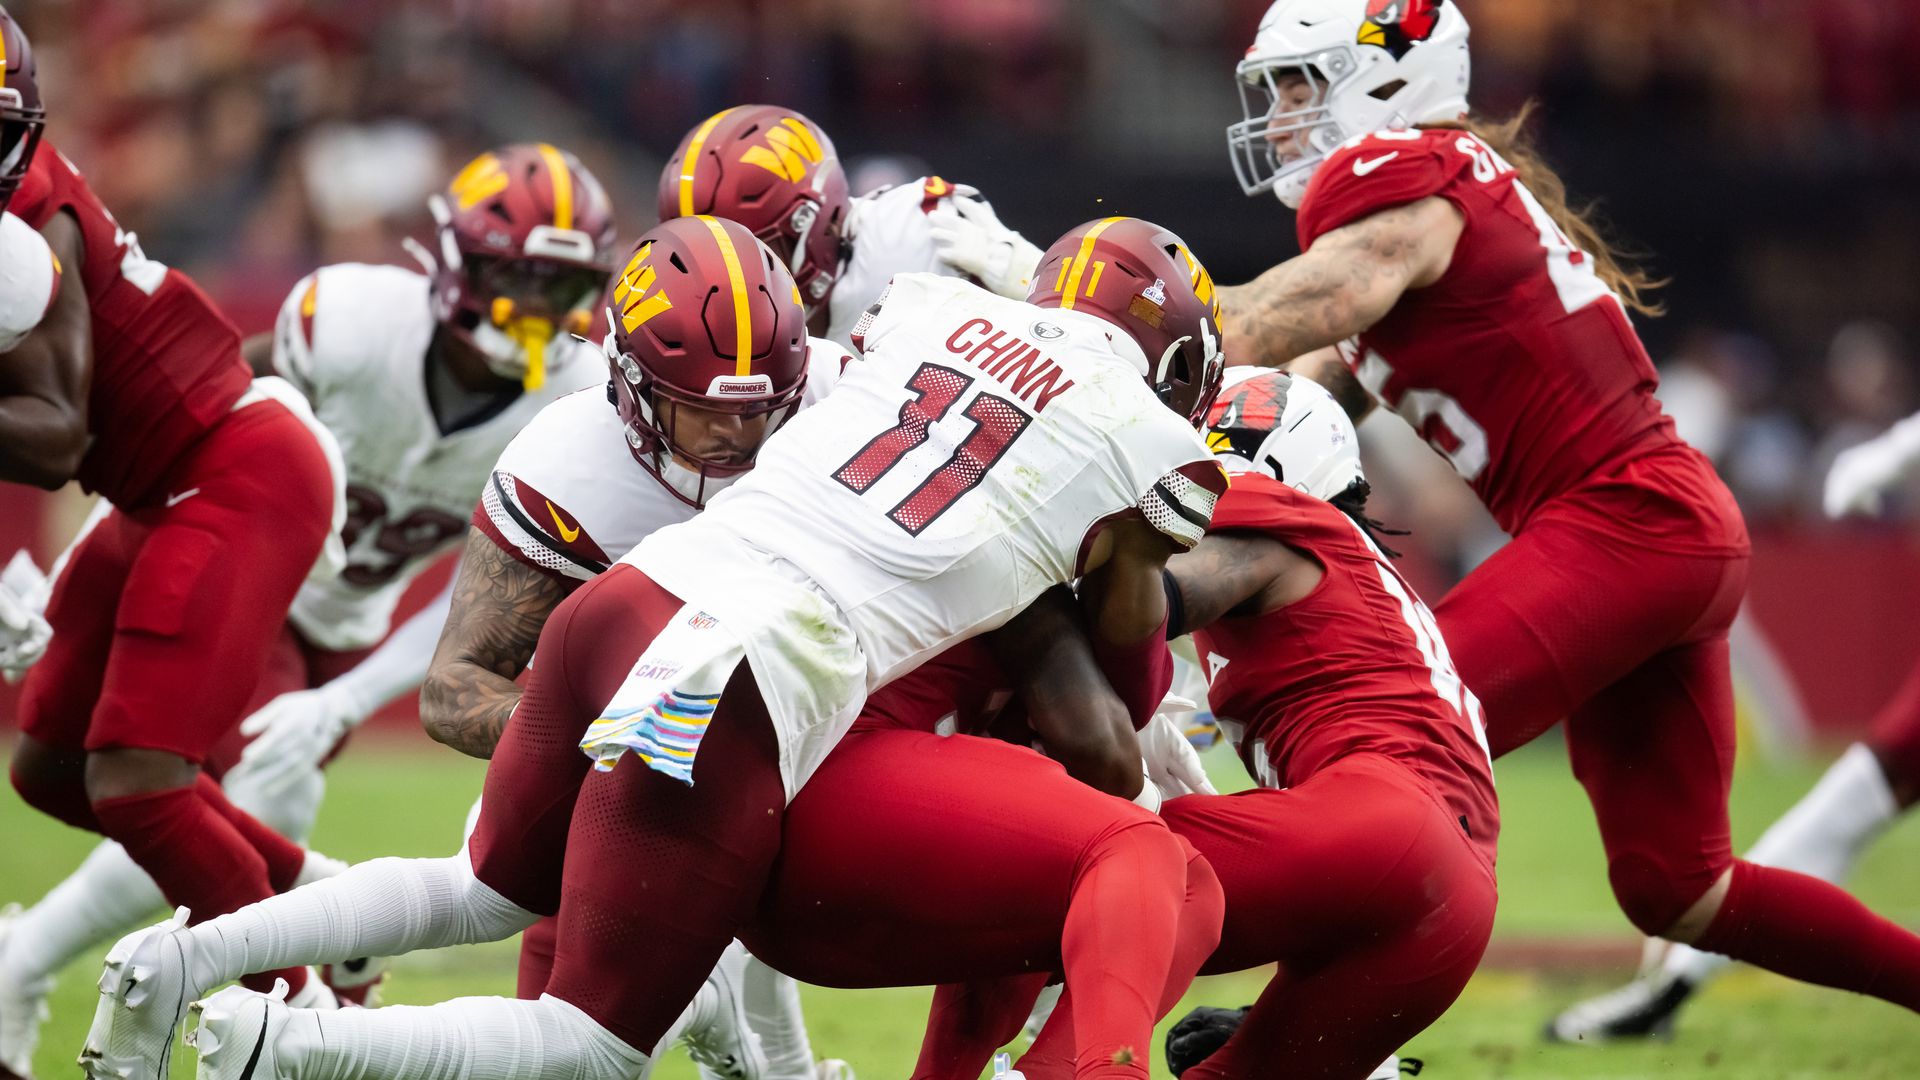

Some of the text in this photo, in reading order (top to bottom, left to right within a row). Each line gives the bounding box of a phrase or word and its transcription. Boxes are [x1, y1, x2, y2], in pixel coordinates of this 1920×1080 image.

[719, 384, 767, 393] COMMANDERS
[946, 318, 1075, 414] CHINN
[831, 362, 1034, 538] 11
